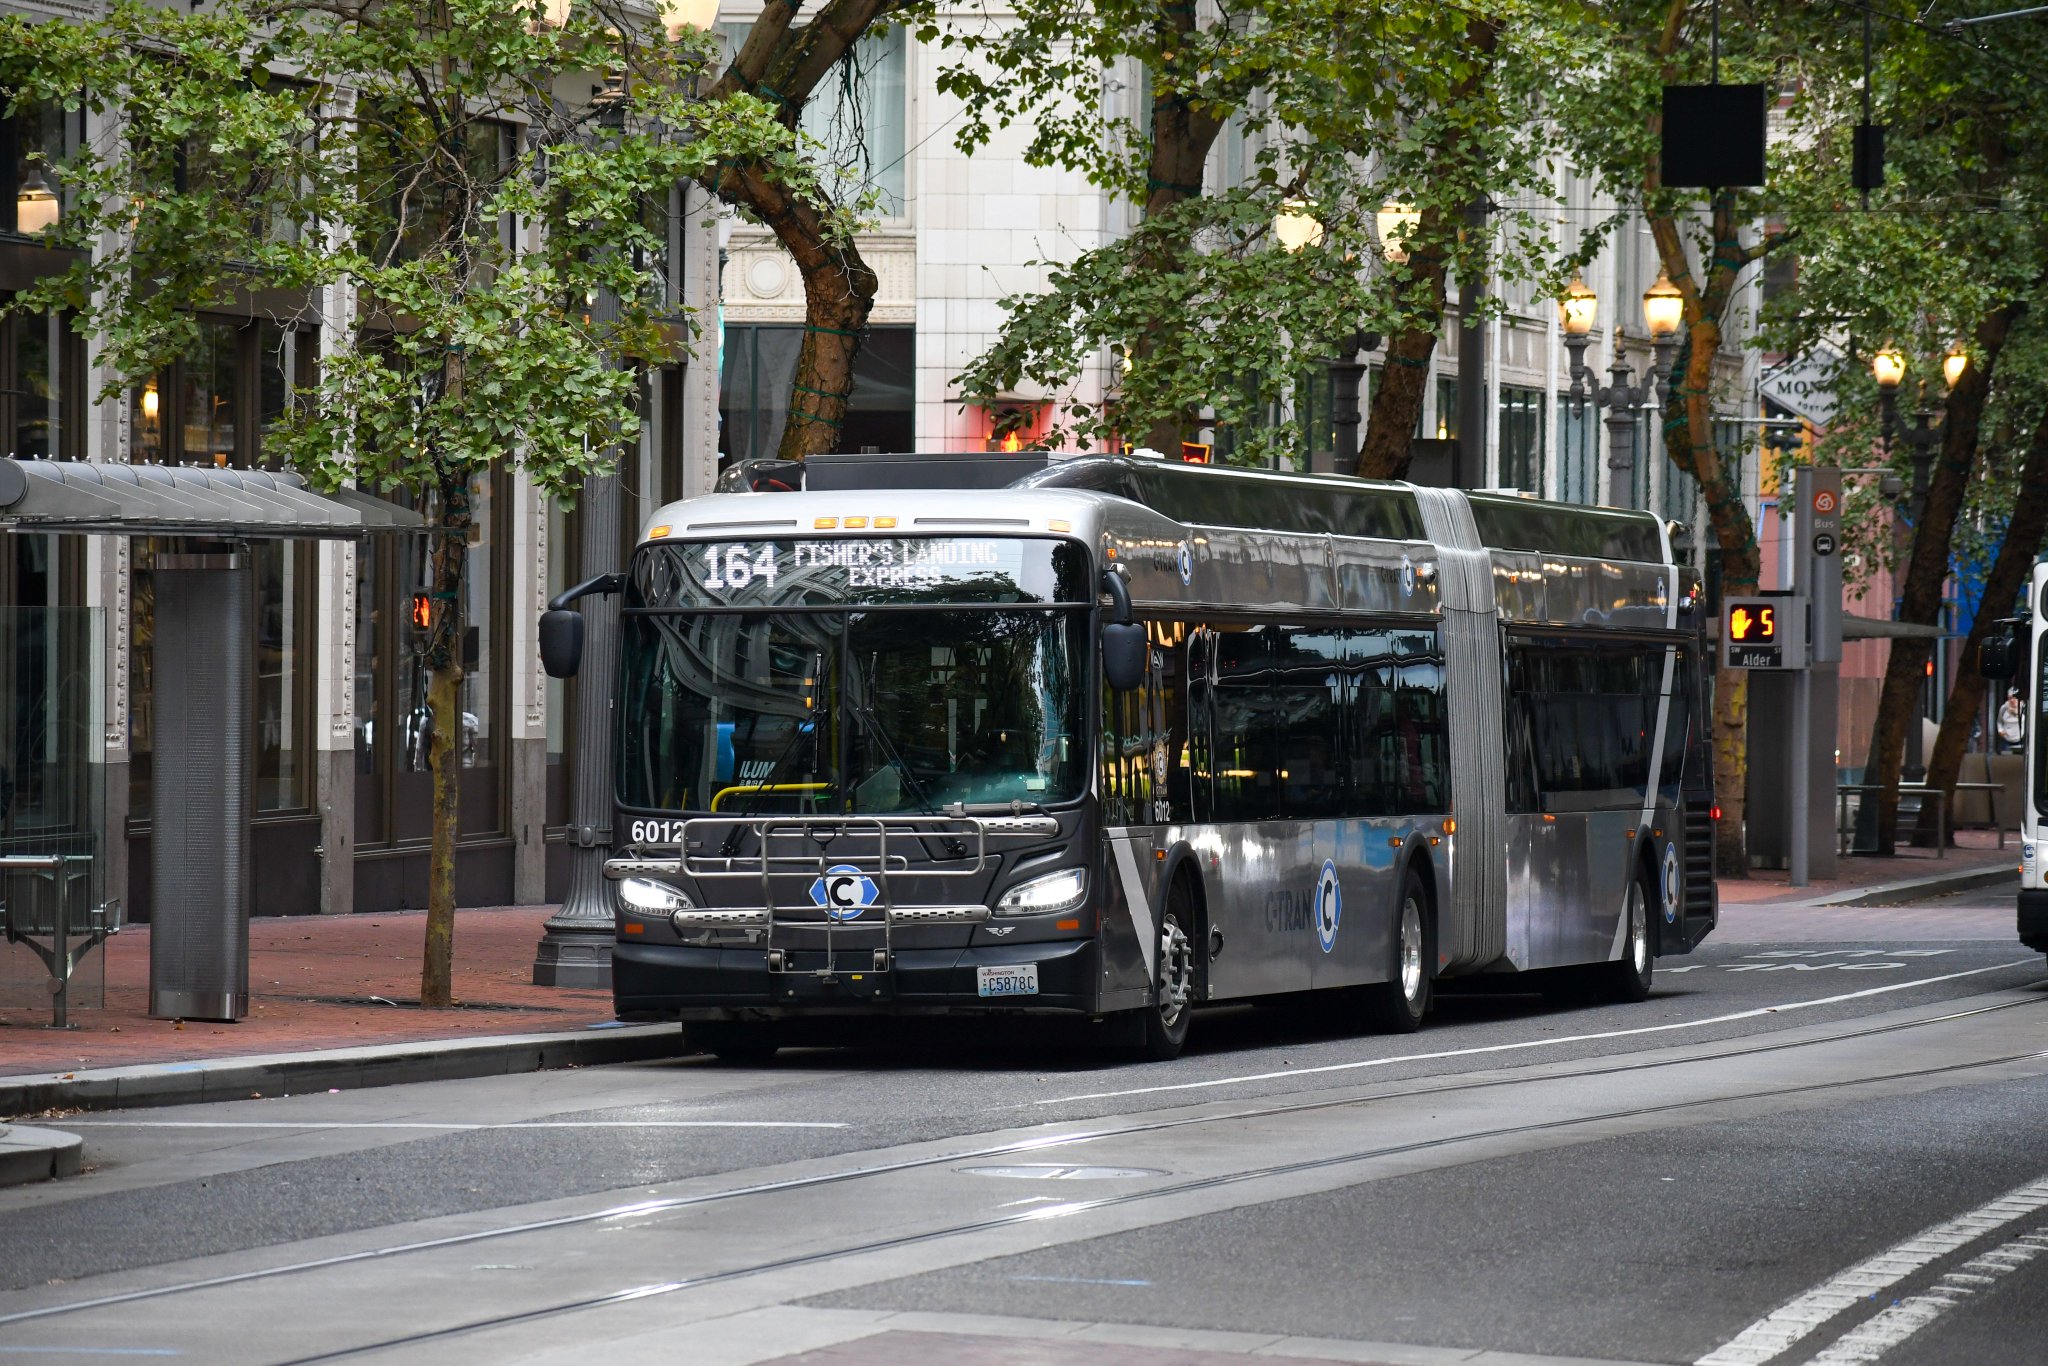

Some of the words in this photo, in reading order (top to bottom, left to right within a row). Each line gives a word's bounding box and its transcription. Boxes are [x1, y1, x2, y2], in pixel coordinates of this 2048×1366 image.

[1814, 519, 1834, 529] Bus
[795, 544, 893, 566] FISHER'S
[902, 542, 998, 565] LANDING
[703, 545, 777, 588] 164
[849, 567, 942, 587] EXPRESS
[1761, 609, 1773, 636] 5
[1742, 653, 1771, 667] Alder
[1154, 801, 1171, 822] 6012
[631, 820, 684, 843] 6012
[830, 877, 855, 907] C
[1265, 889, 1312, 933] C-TRAN
[1323, 879, 1333, 932] C
[989, 976, 1034, 992] C5878C
